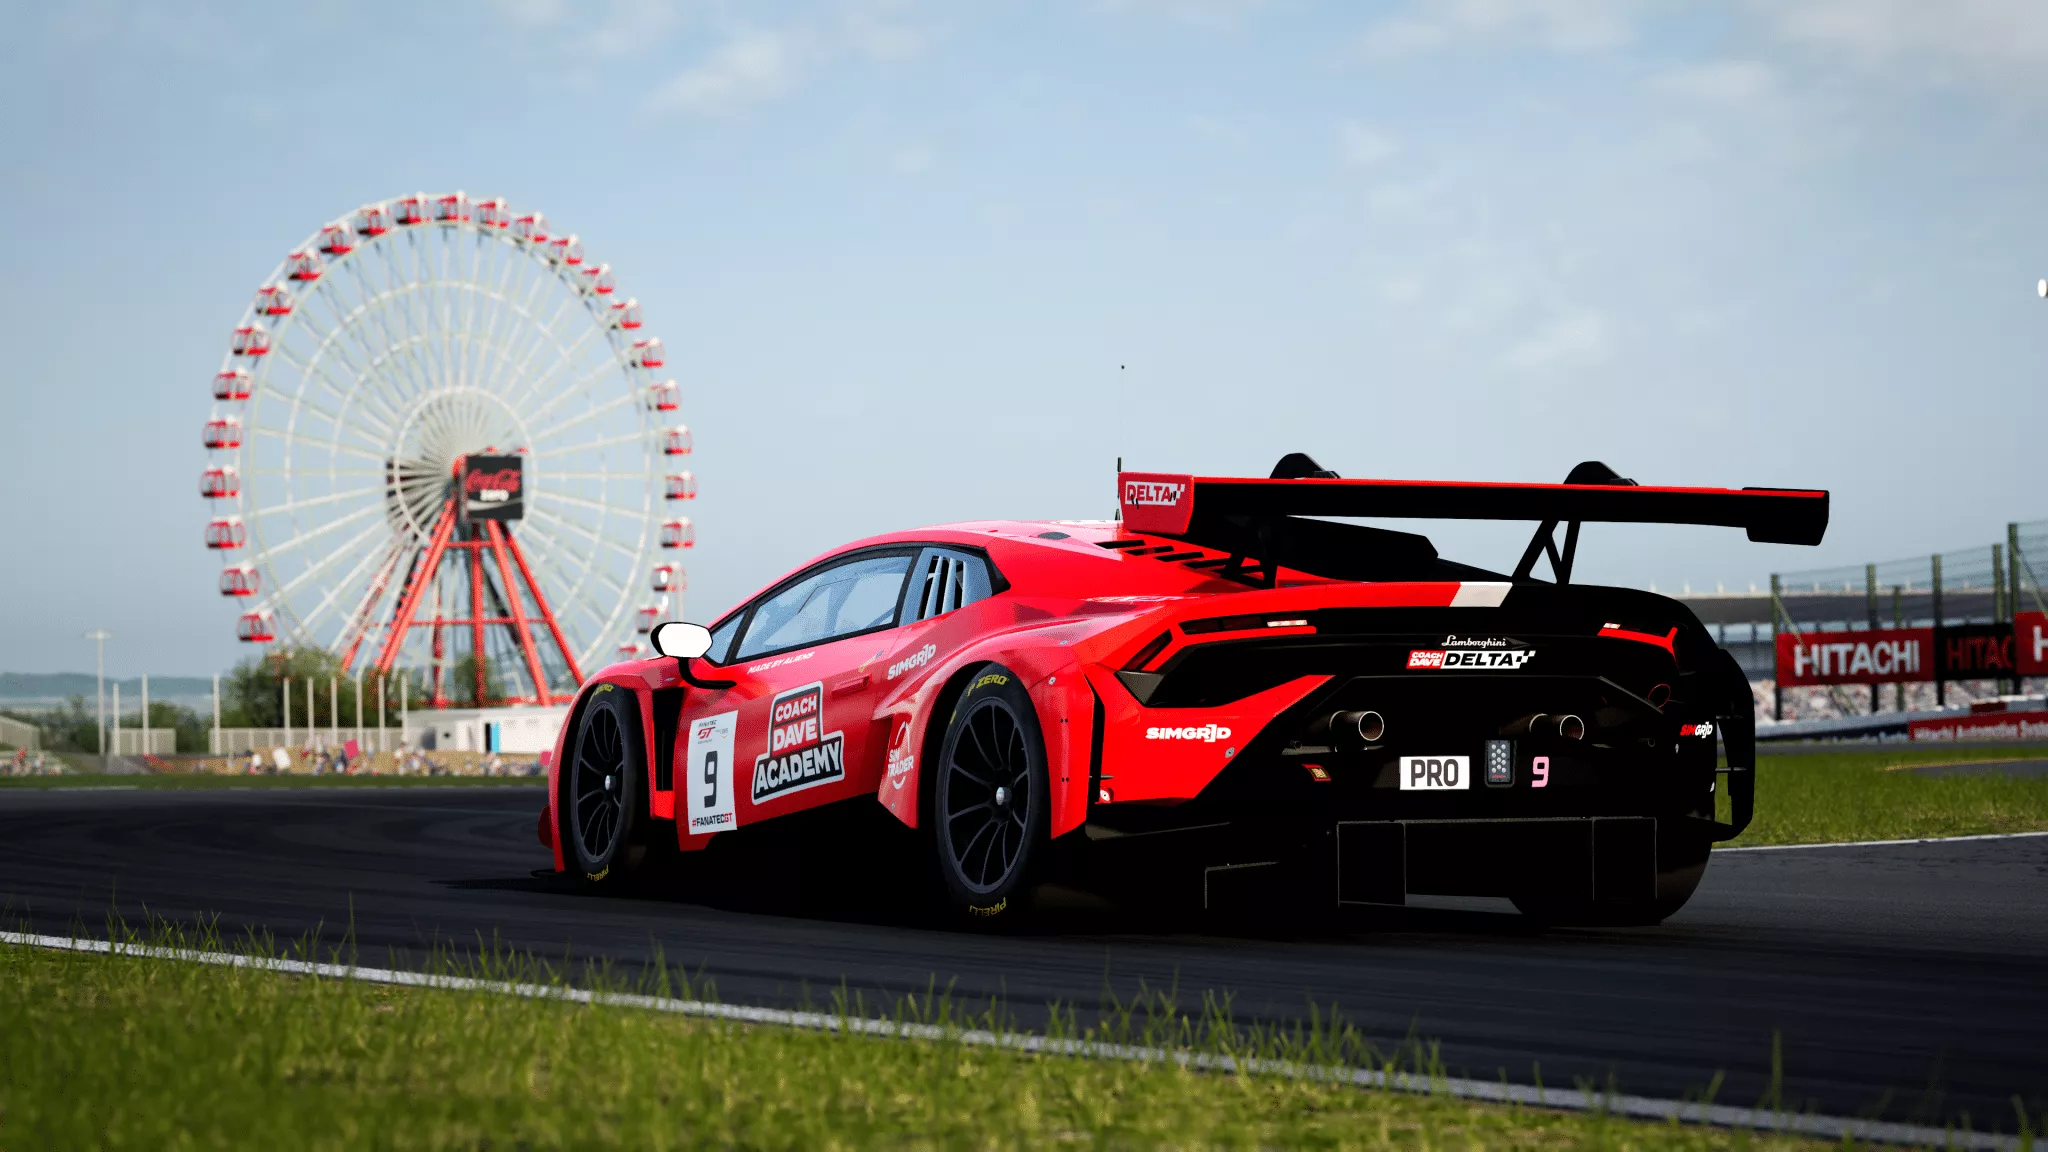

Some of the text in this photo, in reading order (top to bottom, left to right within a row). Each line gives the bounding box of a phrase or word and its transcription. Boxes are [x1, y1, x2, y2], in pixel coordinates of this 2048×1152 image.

[1127, 485, 1170, 502] DELTA
[1411, 651, 1444, 659] COACH
[1441, 635, 1507, 648] Lamborghini
[1409, 658, 1442, 667] DAVE
[1443, 653, 1514, 667] DELTA
[1794, 640, 1920, 676] HITACHI
[776, 694, 817, 722] COACH
[773, 717, 818, 752] DAVE
[704, 750, 718, 809] 9
[756, 741, 842, 794] ACADEMY
[1410, 759, 1459, 787] PRO
[1531, 756, 1550, 788] 9
